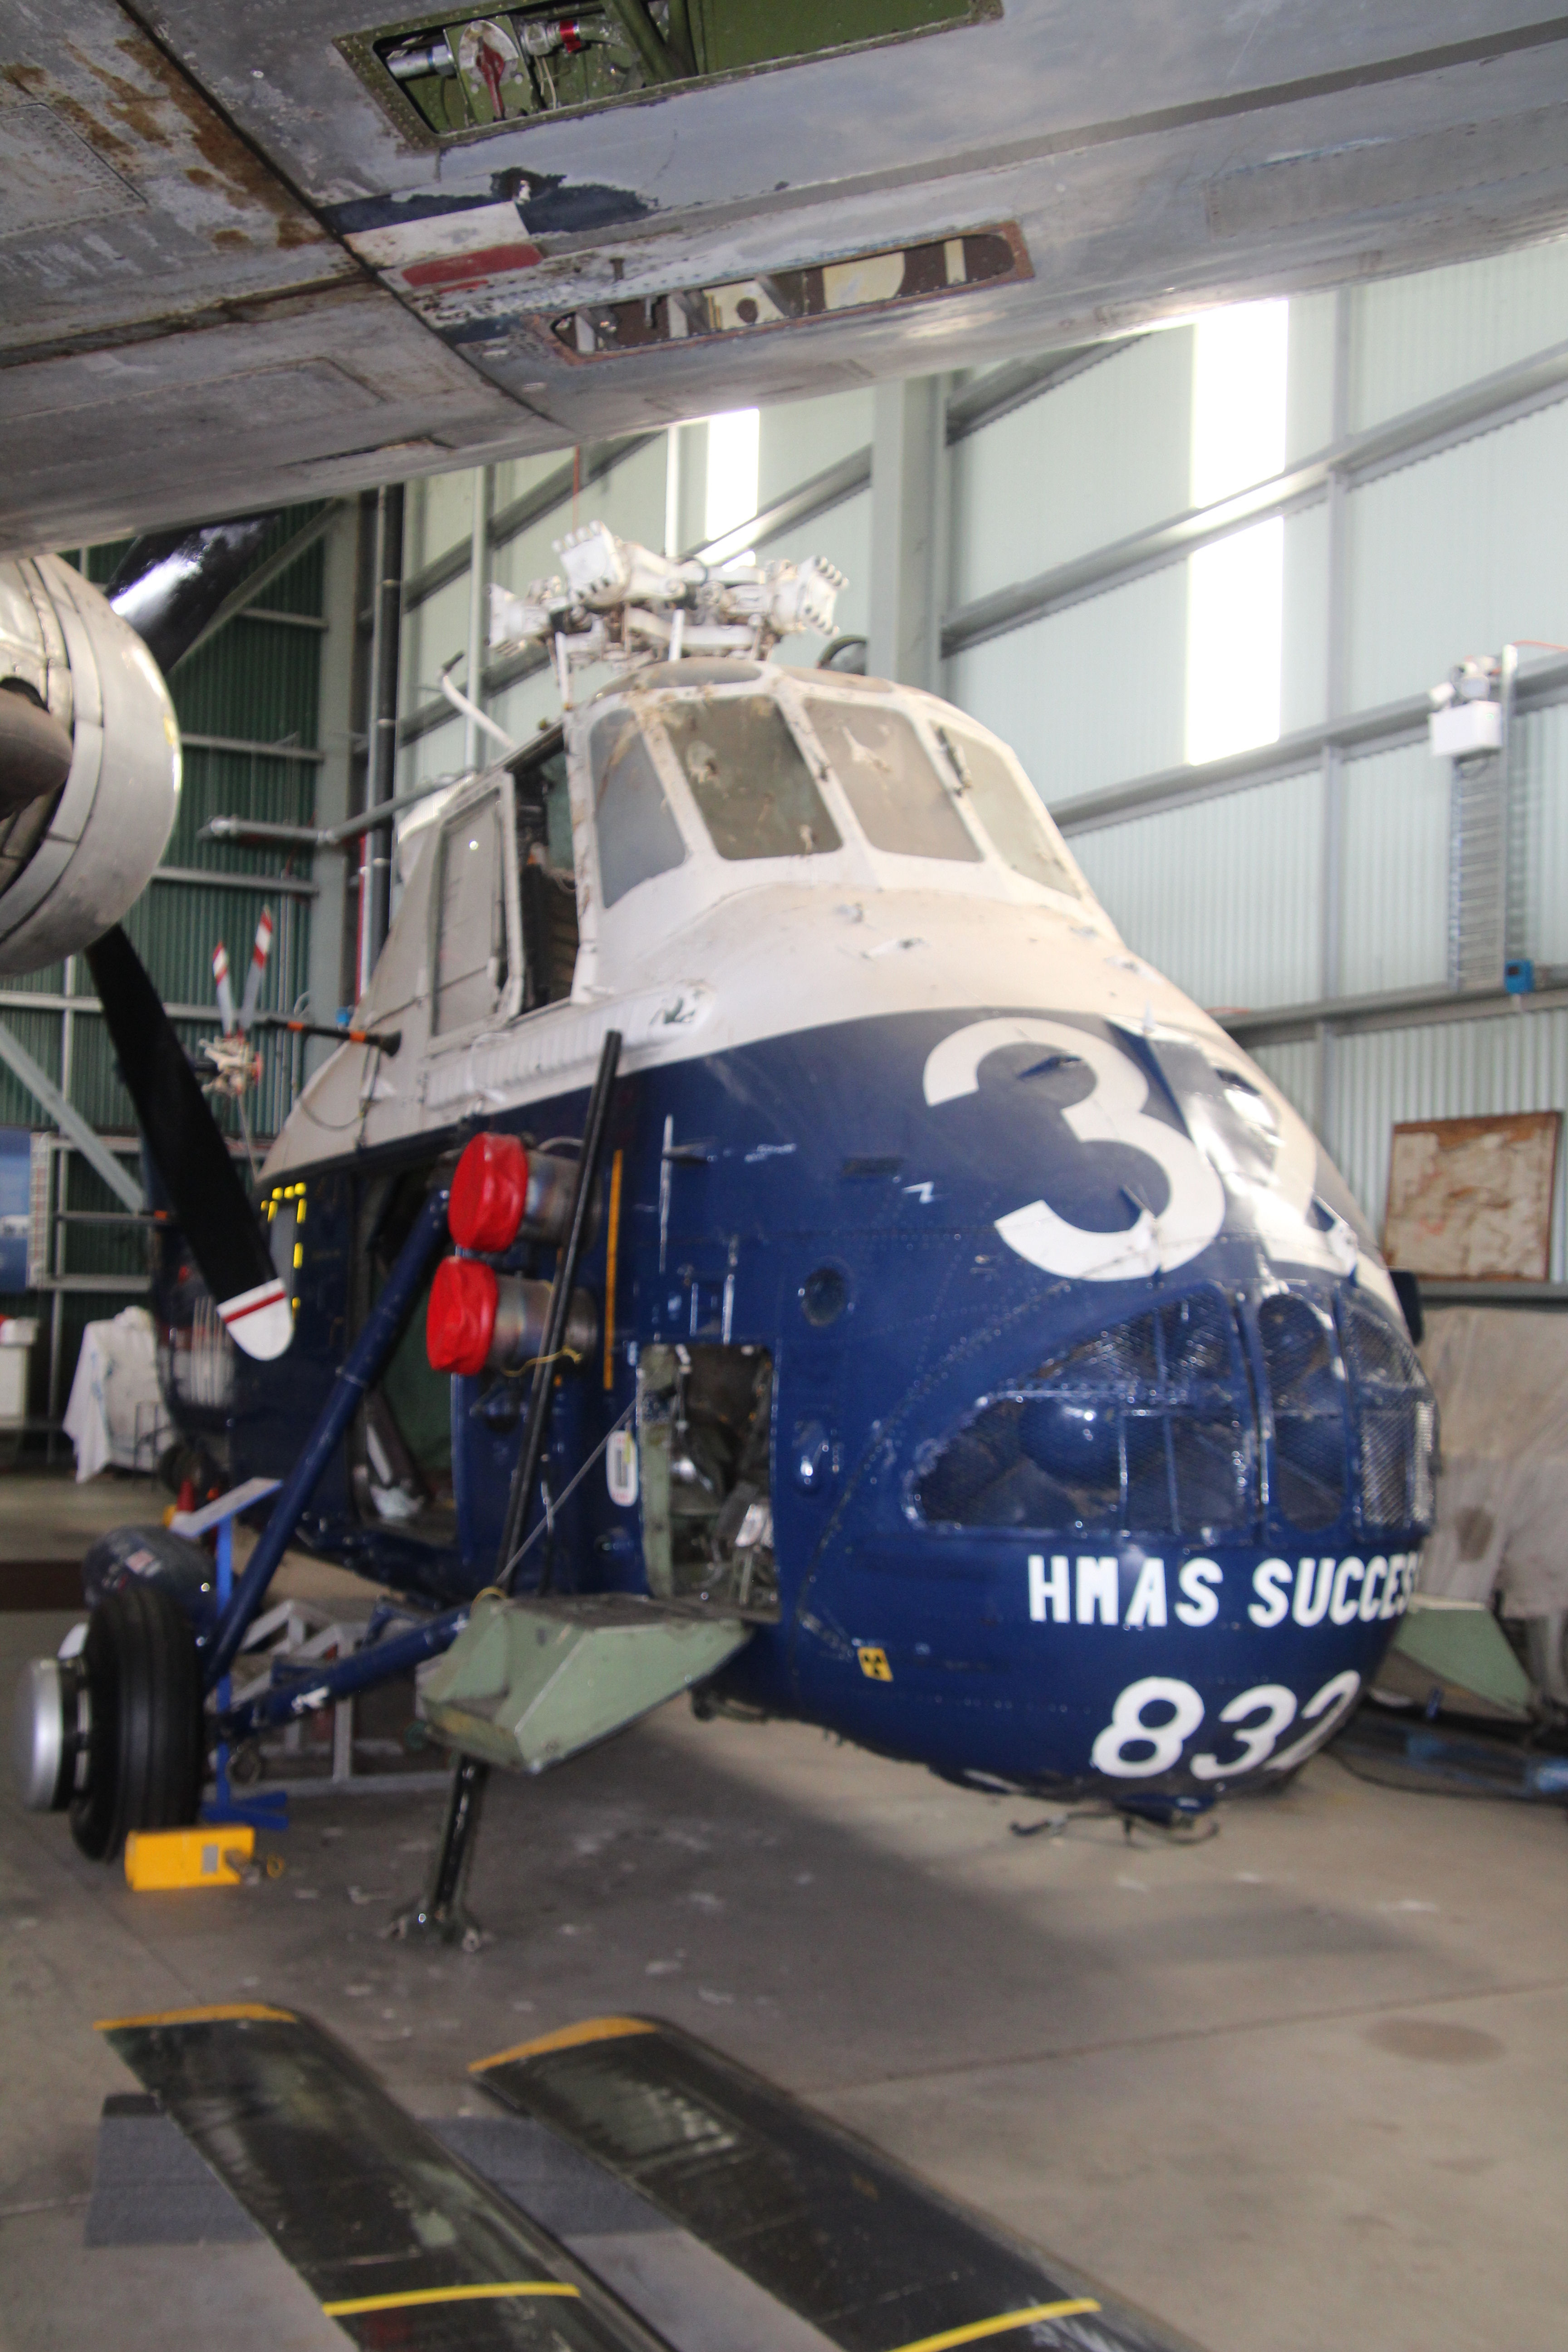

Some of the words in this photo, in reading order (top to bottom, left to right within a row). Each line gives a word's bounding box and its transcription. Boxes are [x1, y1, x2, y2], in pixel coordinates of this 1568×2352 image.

[1028, 1555, 1224, 1627] HMAS
[1248, 1552, 1424, 1628] SUCCES
[1092, 1670, 1361, 1780] 832
